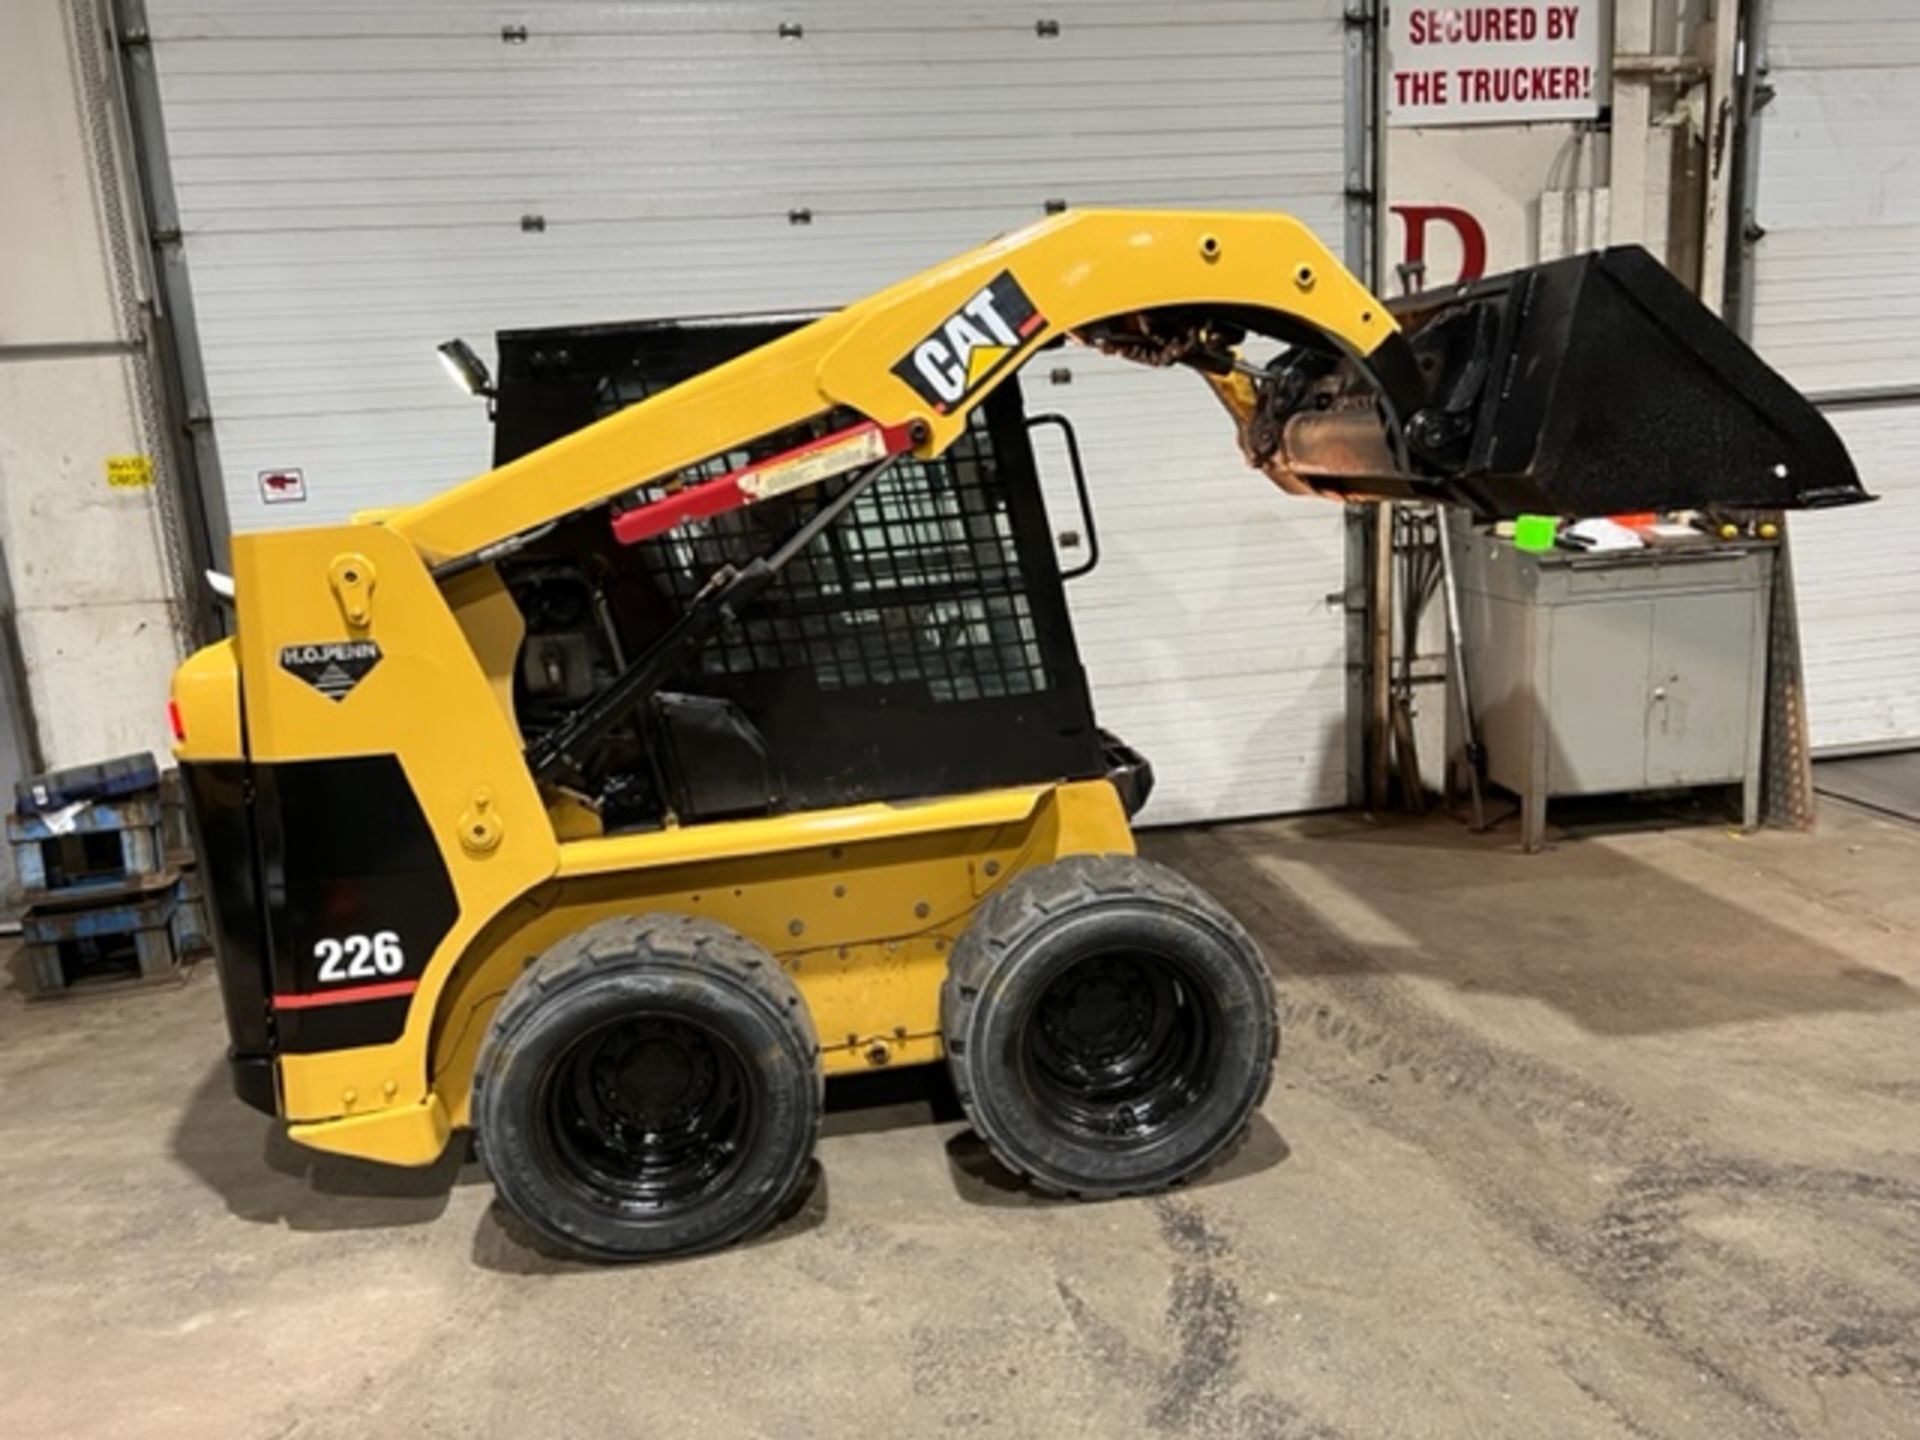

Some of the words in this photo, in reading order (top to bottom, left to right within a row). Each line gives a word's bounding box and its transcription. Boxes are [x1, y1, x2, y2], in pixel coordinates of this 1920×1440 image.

[1409, 8, 1537, 44] SECURED
[1547, 6, 1579, 40] BY
[1395, 71, 1447, 106] THE
[1457, 66, 1590, 103] TRUCKER!
[914, 288, 1020, 402] CAT
[314, 930, 405, 982] 226
